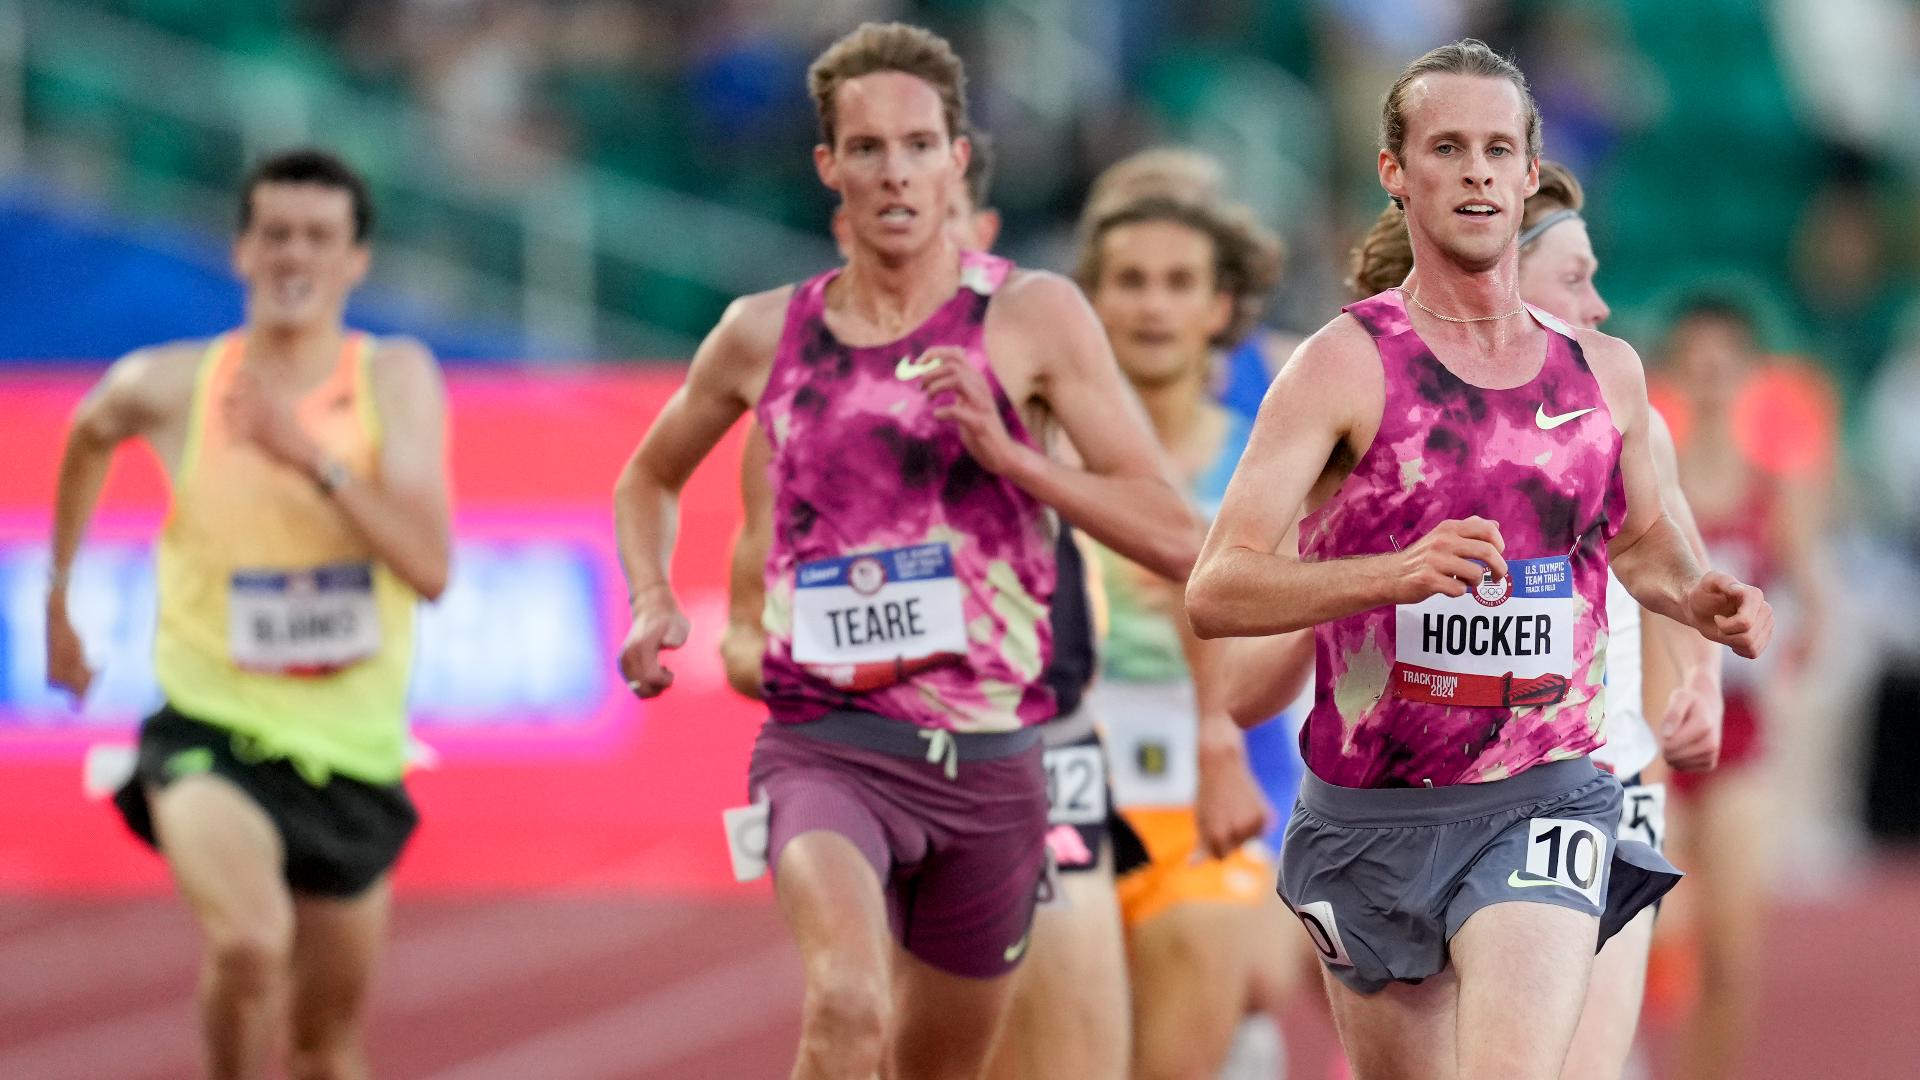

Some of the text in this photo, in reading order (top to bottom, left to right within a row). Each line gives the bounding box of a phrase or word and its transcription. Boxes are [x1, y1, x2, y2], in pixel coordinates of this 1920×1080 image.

[1525, 562, 1565, 575] U.S. OLYMPIC
[1525, 572, 1565, 585] TEAM TRIALS
[1525, 585, 1541, 594] TRACK
[1545, 584, 1556, 593] FIELD
[827, 598, 926, 649] TEARE
[1422, 613, 1552, 656] HOCKER
[1430, 683, 1455, 699] 2024
[1046, 756, 1094, 811] 12
[1535, 825, 1598, 890] 10
[1297, 911, 1338, 960] 0
